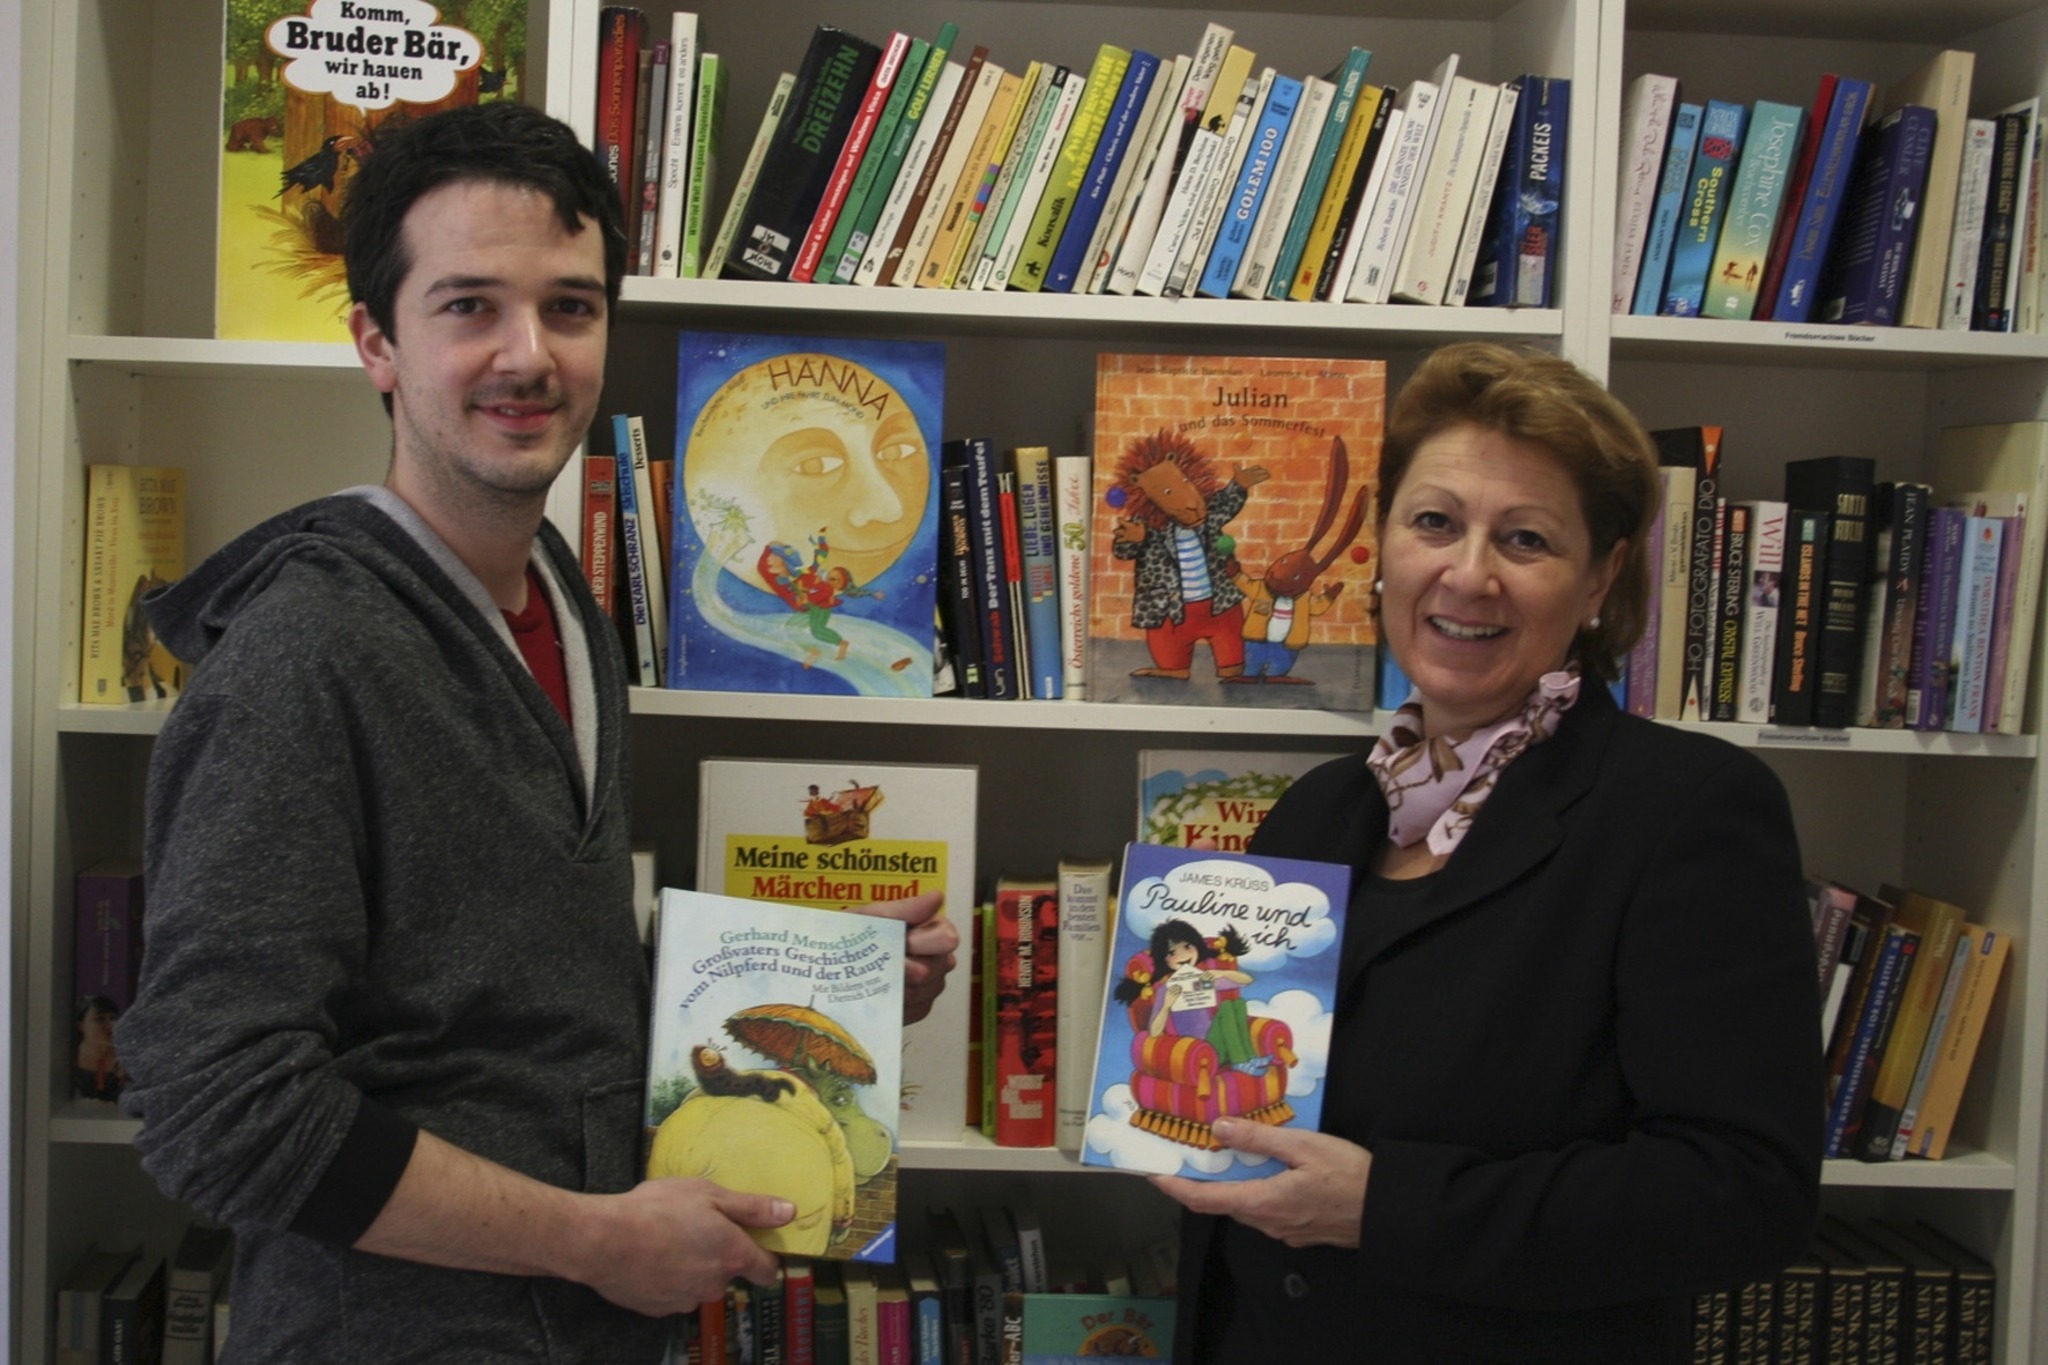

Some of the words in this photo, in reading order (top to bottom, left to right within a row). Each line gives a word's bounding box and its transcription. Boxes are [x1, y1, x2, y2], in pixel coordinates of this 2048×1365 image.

[340, 1, 411, 25] Komm,
[286, 21, 399, 55] Bruder
[403, 29, 470, 65] Bär,
[676, 37, 688, 67] anders
[325, 59, 358, 76] wir
[363, 60, 423, 80] hauen
[608, 14, 627, 114] Sonnenparadies
[906, 89, 928, 121] GOLF
[918, 46, 946, 92] LERNEN
[672, 82, 683, 111] kommt
[800, 44, 859, 155] DREIZEHN
[607, 117, 620, 142] Das
[850, 113, 871, 152] Windows
[867, 89, 881, 112] Vista
[1529, 121, 1552, 182] PACKEIS
[1745, 115, 1796, 210] Josephine
[666, 158, 679, 189] Specht
[1235, 158, 1268, 221] GOLEM
[1257, 125, 1279, 158] 100
[1036, 194, 1066, 248] Konsalik
[1687, 176, 1709, 229] Cross
[1695, 165, 1723, 244] Southern
[1741, 210, 1771, 252] Cox
[768, 358, 889, 420] HANNA
[1212, 387, 1288, 408] Julian
[1179, 417, 1206, 433] und
[1212, 414, 1235, 428] das
[1241, 413, 1325, 438] Sommerfest
[634, 427, 645, 470] Desserts
[972, 439, 988, 487] Teufel
[617, 452, 633, 509] Skischule
[1036, 460, 1052, 529] GEHEIMNISSE
[1697, 478, 1716, 510] DIO
[977, 487, 990, 518] dem
[1902, 490, 1917, 524] JEAN
[593, 511, 606, 575] STEPPENWIND
[624, 517, 640, 571] SCHRANZ
[981, 519, 993, 546] mit
[1040, 529, 1053, 556] UND
[1727, 532, 1744, 567] BRUCE
[1758, 515, 1783, 566] Will
[1898, 527, 1913, 574] PLAIDY
[592, 577, 605, 594] DER
[983, 548, 996, 582] Tanz
[1068, 554, 1083, 601] goldene
[1687, 515, 1714, 637] FOTOGRAFATO
[631, 573, 643, 604] KARL
[986, 582, 999, 609] Der
[1724, 568, 1742, 617] STERLING
[1976, 575, 1993, 635] DOROTHEA
[634, 605, 645, 625] Die
[1067, 603, 1083, 669] Österreichs
[1684, 641, 1704, 671] HO
[1720, 619, 1737, 660] CRYSTAL
[1972, 636, 1986, 682] BENTON
[1967, 683, 1981, 721] FRANK
[735, 846, 809, 869] Meine
[816, 847, 938, 873] schönsten
[752, 875, 863, 899] Märchen
[871, 880, 919, 901] und
[1073, 883, 1093, 894] Das
[1179, 872, 1222, 887] JAMES
[1225, 876, 1270, 892] KRÜSS
[1018, 895, 1033, 941] ROBINSON
[1140, 883, 1249, 920] Pauline
[1253, 906, 1312, 928] und
[720, 927, 788, 944] Gerhard
[792, 925, 878, 950] Mensching
[1251, 924, 1298, 950] ich
[692, 945, 781, 974] Großvaters
[786, 943, 879, 966] Geschichten
[1018, 957, 1033, 987] HENRY
[679, 978, 710, 1009] vom
[707, 958, 778, 983] Nilpferd
[782, 965, 811, 978] und
[815, 967, 842, 980] der
[844, 952, 891, 979] Raupe
[812, 984, 829, 993] Mit
